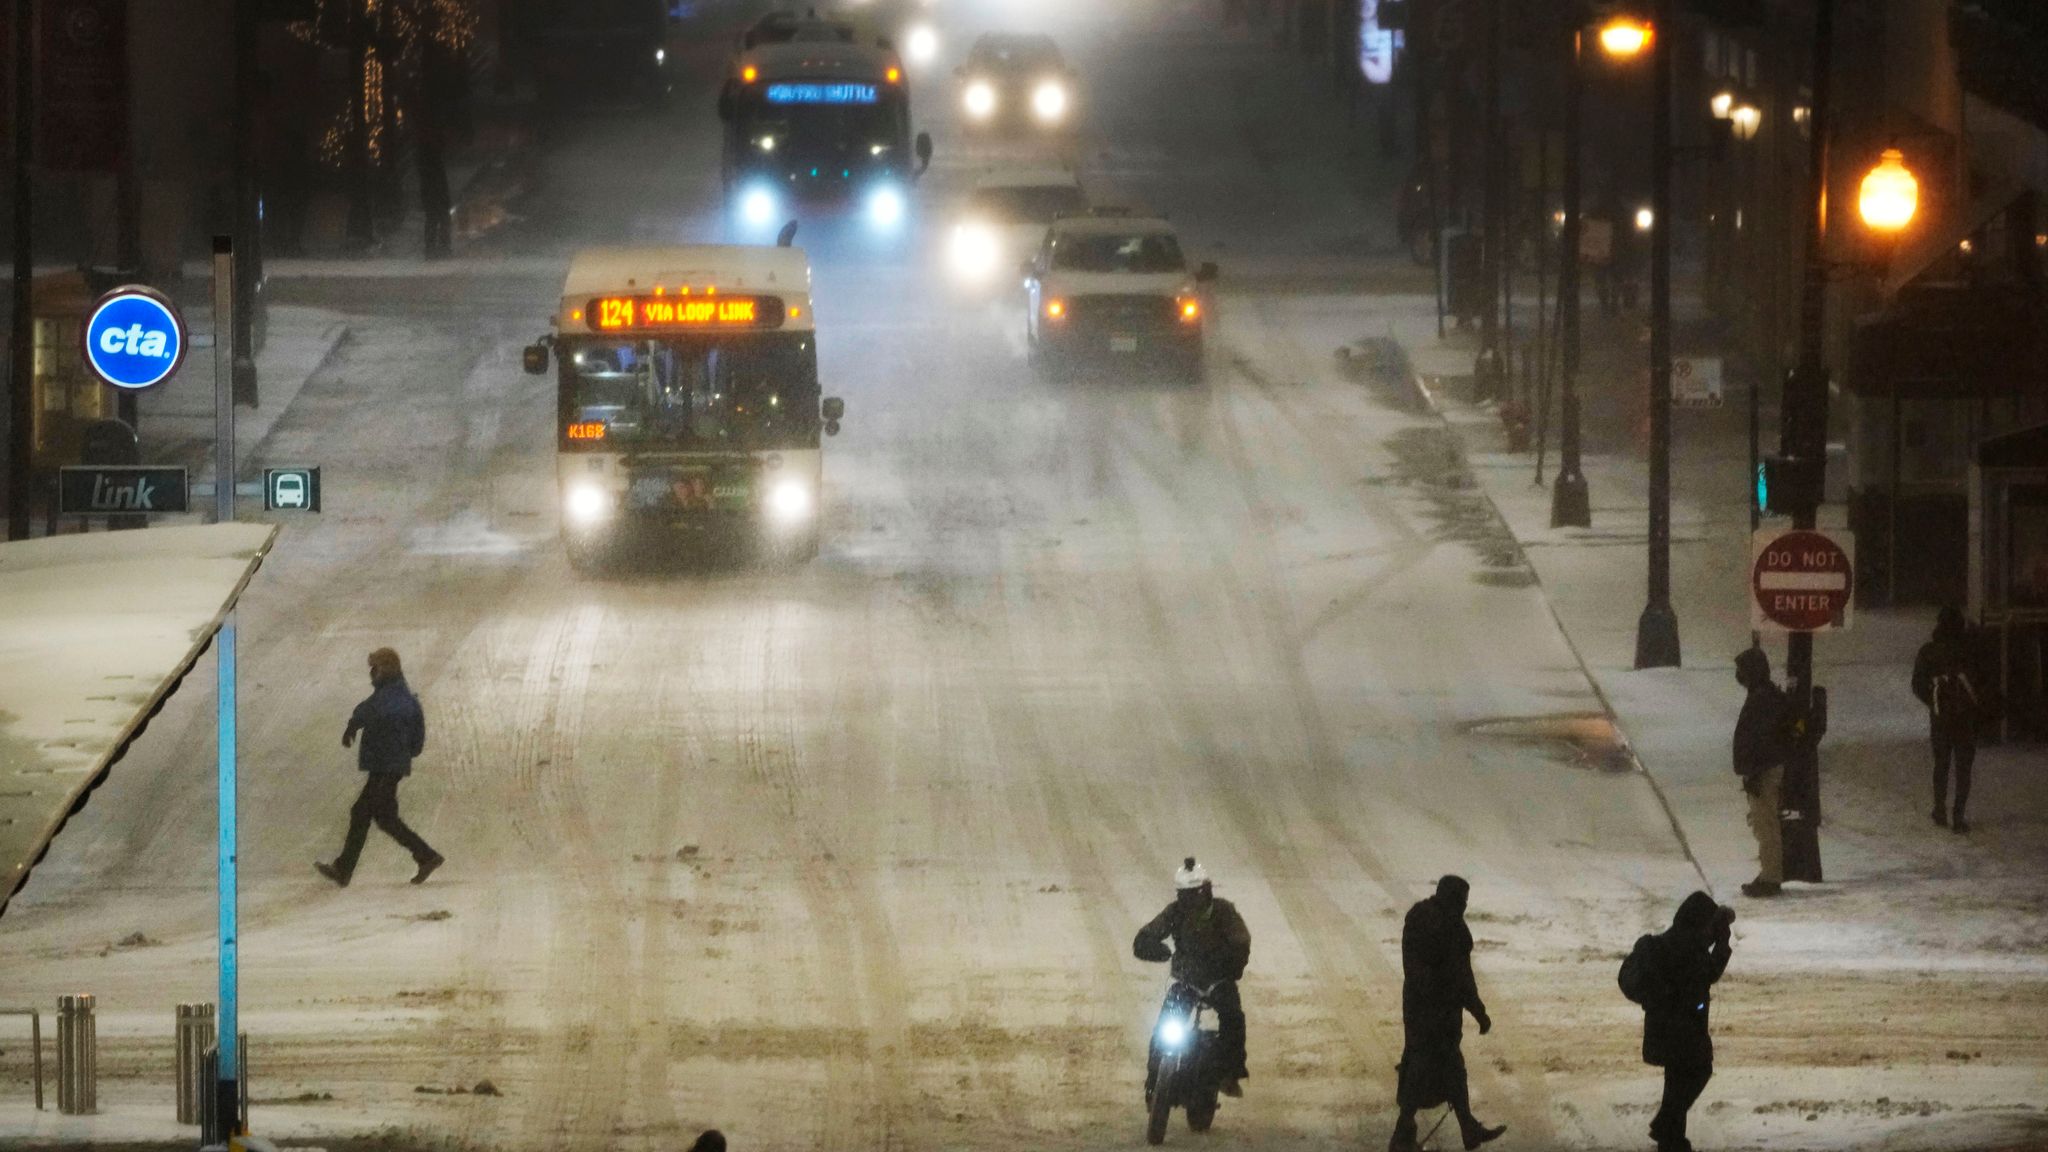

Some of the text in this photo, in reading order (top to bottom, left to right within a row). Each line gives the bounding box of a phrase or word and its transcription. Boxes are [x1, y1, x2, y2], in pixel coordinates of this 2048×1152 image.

[825, 84, 876, 102] SHUTTLE
[600, 299, 754, 327] 124 VIA LOOP LINK
[91, 473, 154, 509] Link
[1768, 551, 1838, 567] DO NOT
[1775, 595, 1830, 611] ENTER
